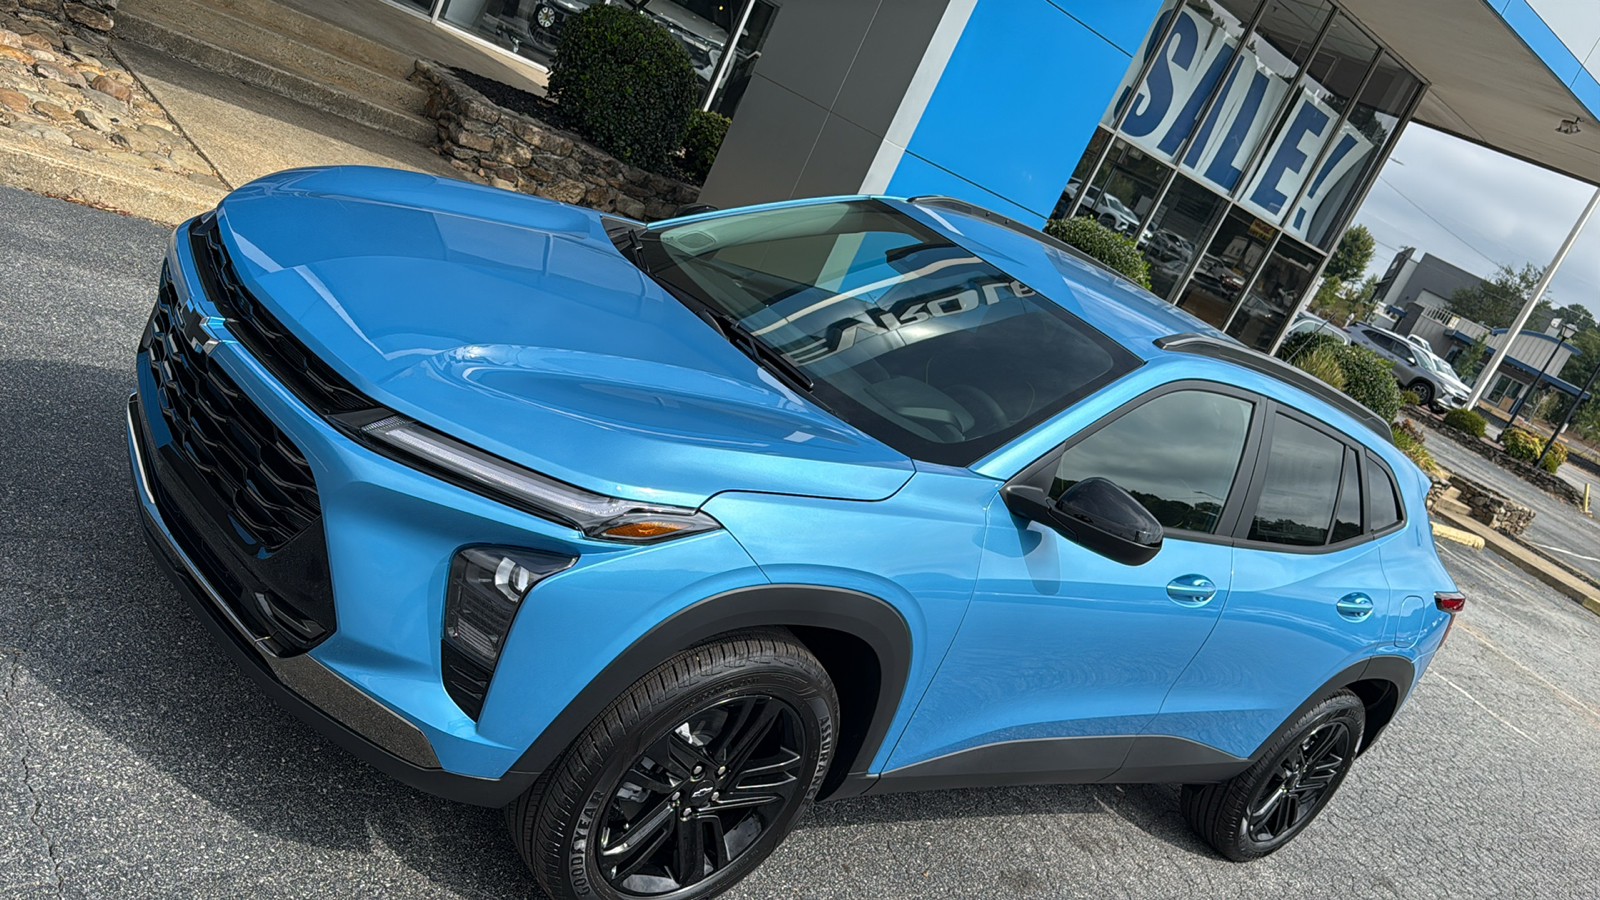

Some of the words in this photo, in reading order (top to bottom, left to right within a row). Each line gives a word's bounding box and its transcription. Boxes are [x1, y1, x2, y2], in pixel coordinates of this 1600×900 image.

[1113, 9, 1358, 231] SALE!
[801, 716, 832, 805] ASSURANC
[569, 791, 605, 897] GOODYEAR
